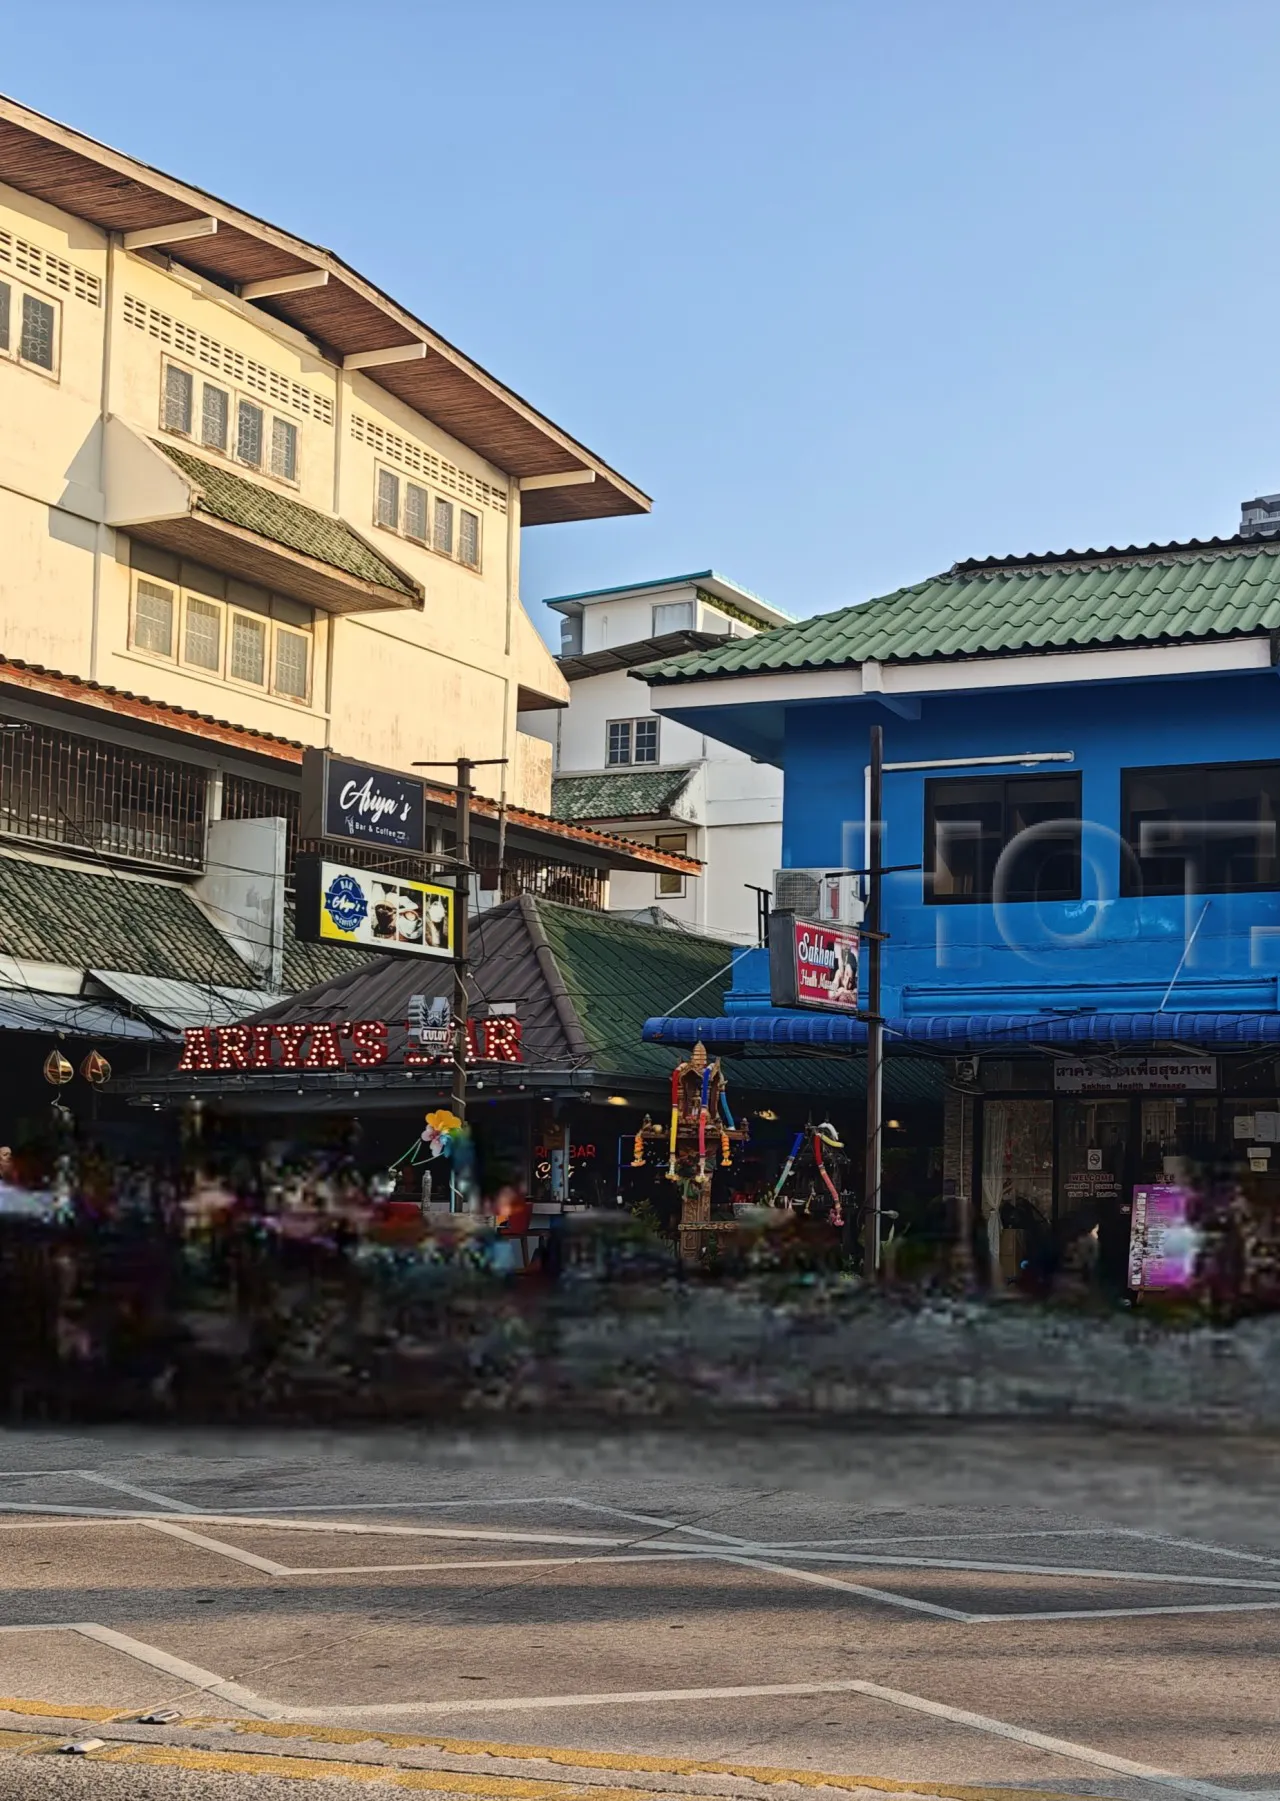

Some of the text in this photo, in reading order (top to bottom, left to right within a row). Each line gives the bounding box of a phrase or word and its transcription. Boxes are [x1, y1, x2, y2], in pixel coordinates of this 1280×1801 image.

[340, 777, 411, 823] Ariya's
[355, 821, 396, 838] Bar & Coffee
[798, 932, 835, 969] Sakhon
[178, 1017, 523, 1069] ARIYA'S AR
[422, 1030, 448, 1041] KULOV
[1081, 1082, 1111, 1090] Sakhon
[1117, 1082, 1144, 1090] Health
[1070, 1173, 1114, 1182] WELCOME
